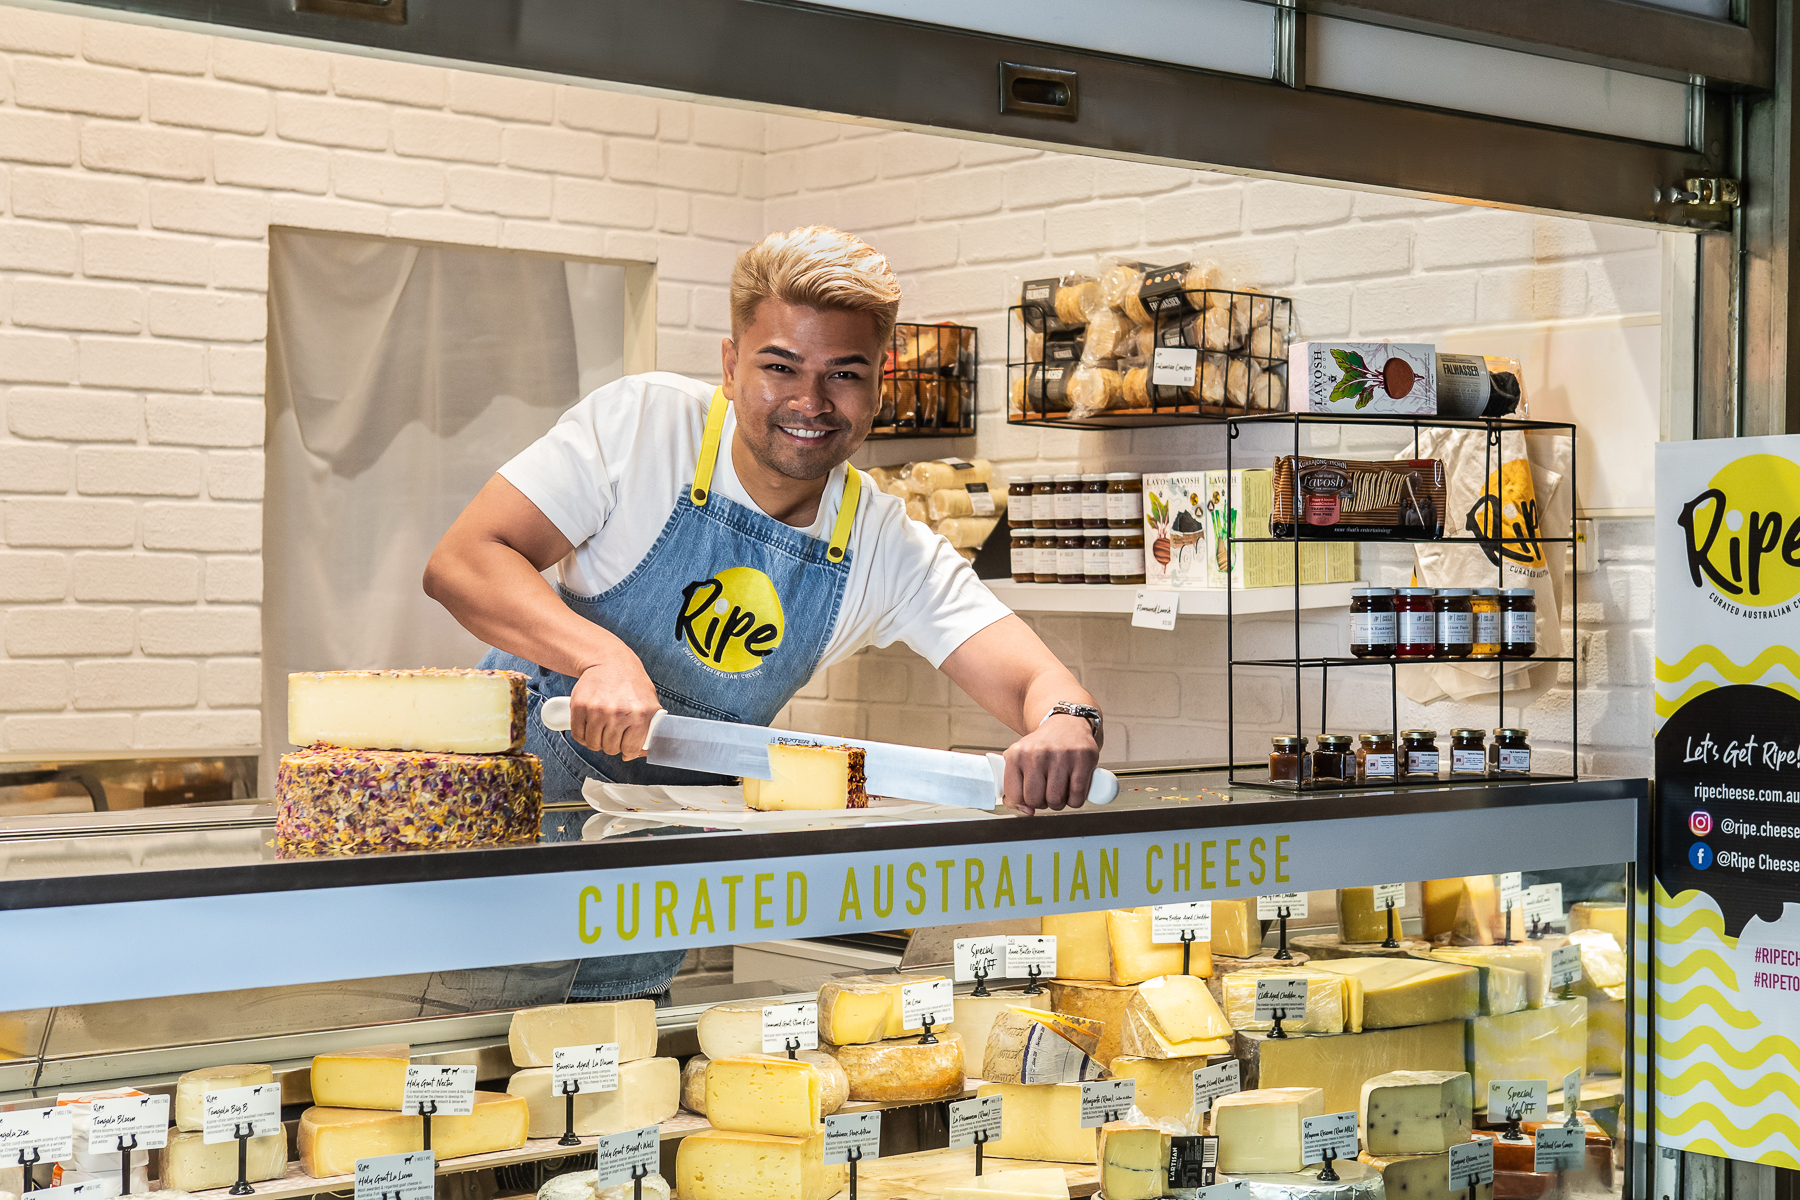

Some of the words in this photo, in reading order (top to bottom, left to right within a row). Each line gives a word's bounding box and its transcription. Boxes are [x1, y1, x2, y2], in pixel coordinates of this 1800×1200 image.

[1443, 364, 1480, 377] FALWASSER
[1147, 477, 1169, 486] LAVOS
[1171, 476, 1200, 485] LAVOSH
[1209, 476, 1237, 484] LAVOH
[1302, 475, 1344, 489] Lavosh
[1465, 494, 1541, 567] Rip
[1677, 488, 1800, 596] Ripe
[1510, 566, 1536, 578] CURATED
[1709, 592, 1740, 616] CURATED
[1743, 606, 1791, 619] AUSTRALIAN
[675, 579, 777, 663] Ripe
[682, 646, 701, 669] CURATED
[702, 665, 738, 680] AUSTRALIAN
[741, 669, 763, 679] CHEESE
[1683, 733, 1719, 763] Let's
[1723, 734, 1758, 768] Get
[1694, 782, 1800, 804] ripecheese.com.au
[1721, 818, 1800, 839] @ripe.cheese
[1717, 851, 1755, 872] @Ripe
[1759, 854, 1800, 872] Cheese
[578, 869, 810, 946] CURATED
[838, 847, 1120, 923] AUSTRALIAN
[1146, 834, 1293, 896] CHEESE
[970, 943, 994, 958] Special
[556, 1063, 574, 1071] Barossa
[577, 1059, 590, 1071] Aged
[592, 1059, 598, 1068] La
[600, 1058, 614, 1066] Dame
[406, 1080, 420, 1088] Holy
[421, 1077, 435, 1088] Goat
[436, 1077, 454, 1087] Nectar
[1507, 1086, 1534, 1101] Special
[93, 1104, 104, 1112] Ripe
[207, 1105, 229, 1118] Tongola
[231, 1104, 241, 1115] Big
[242, 1102, 248, 1112] B
[1520, 1101, 1537, 1114] OFF
[93, 1116, 116, 1128] Tongola
[117, 1114, 136, 1124] Bloom
[16, 1129, 30, 1138] Zoe
[601, 1150, 612, 1160] Holy
[613, 1144, 625, 1157] Goat
[643, 1140, 654, 1149] Well
[1169, 1147, 1178, 1180] L'ARTISAN
[358, 1175, 373, 1186] Holy
[374, 1171, 389, 1184] Goat
[390, 1172, 397, 1182] La
[398, 1171, 413, 1181] Luna
